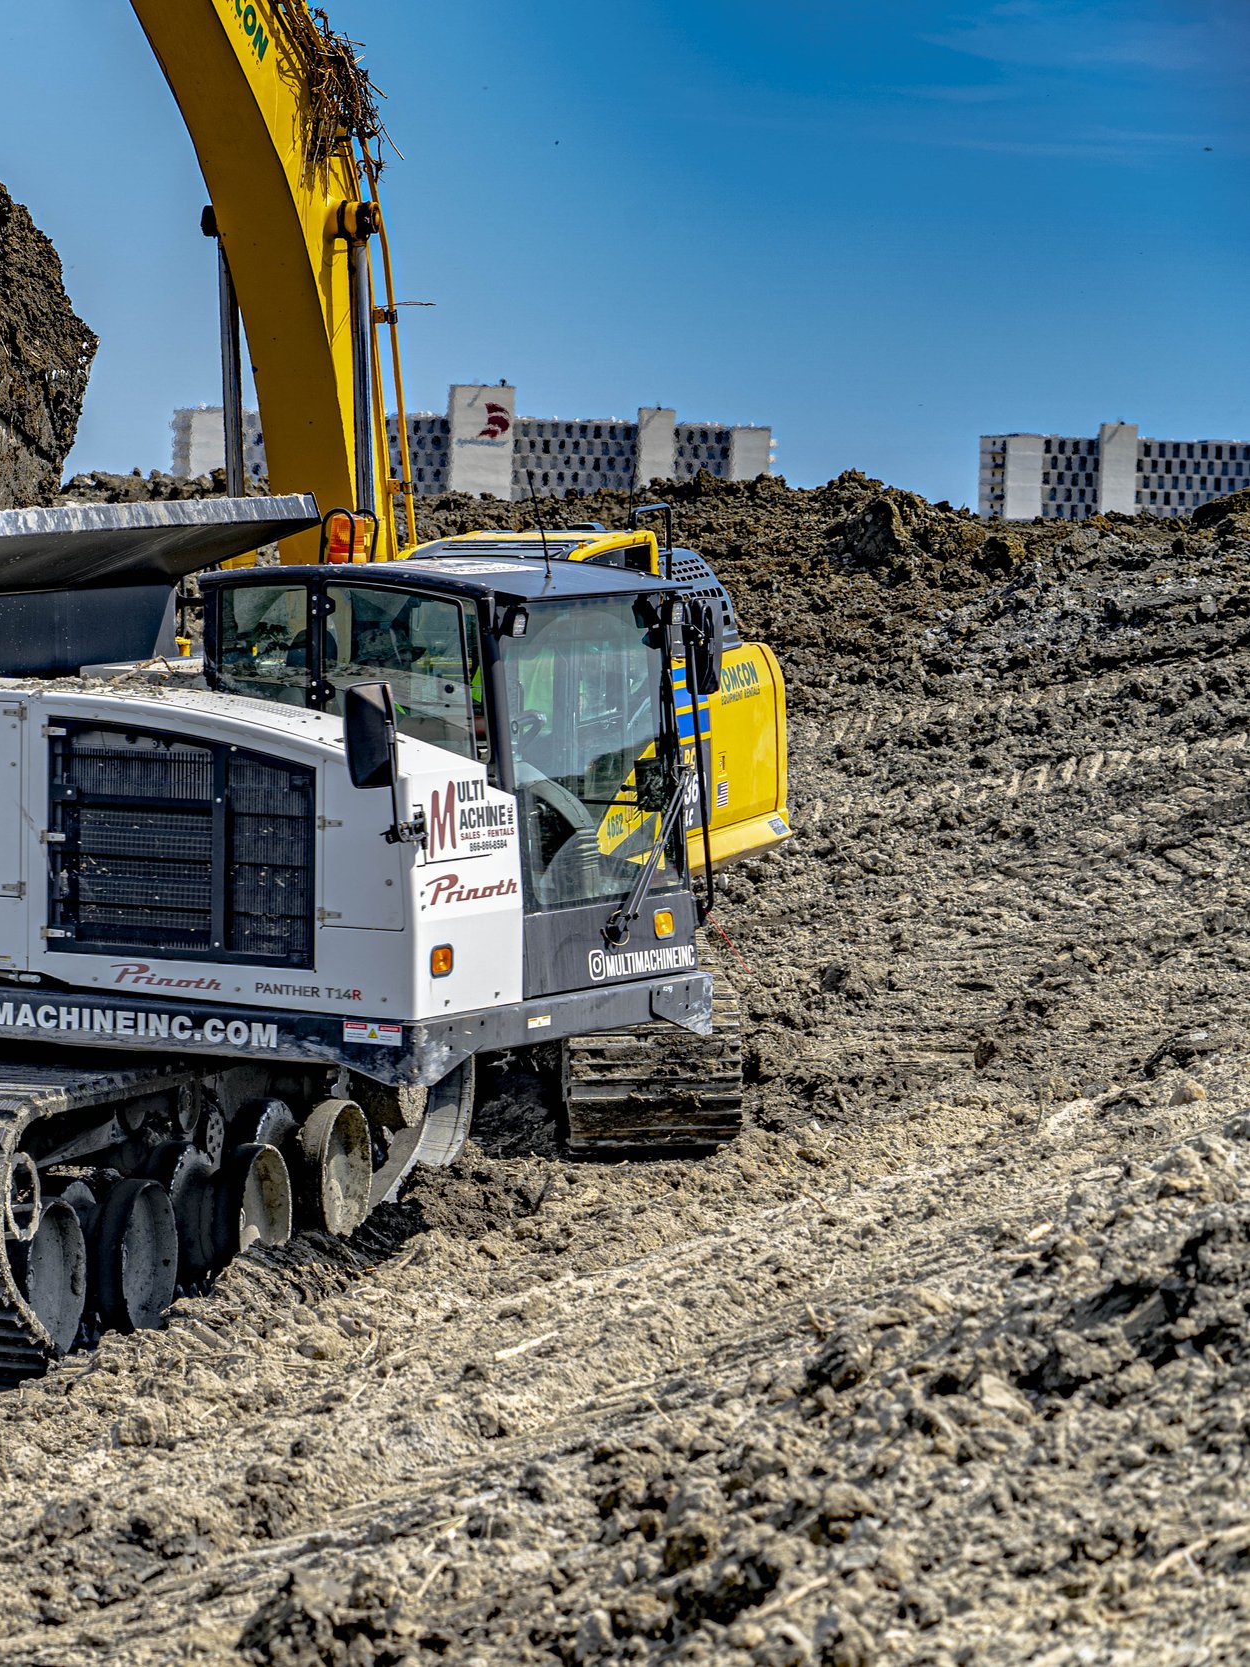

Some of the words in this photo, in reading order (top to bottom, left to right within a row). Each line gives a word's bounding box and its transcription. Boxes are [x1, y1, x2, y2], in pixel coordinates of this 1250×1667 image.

[460, 831, 481, 841] SALES
[425, 873, 518, 906] Prinoth
[606, 944, 695, 977] MULTIMACHINEINC
[109, 962, 222, 991] Prinoth
[254, 982, 321, 998] PANTHER
[324, 987, 363, 1001] T14R
